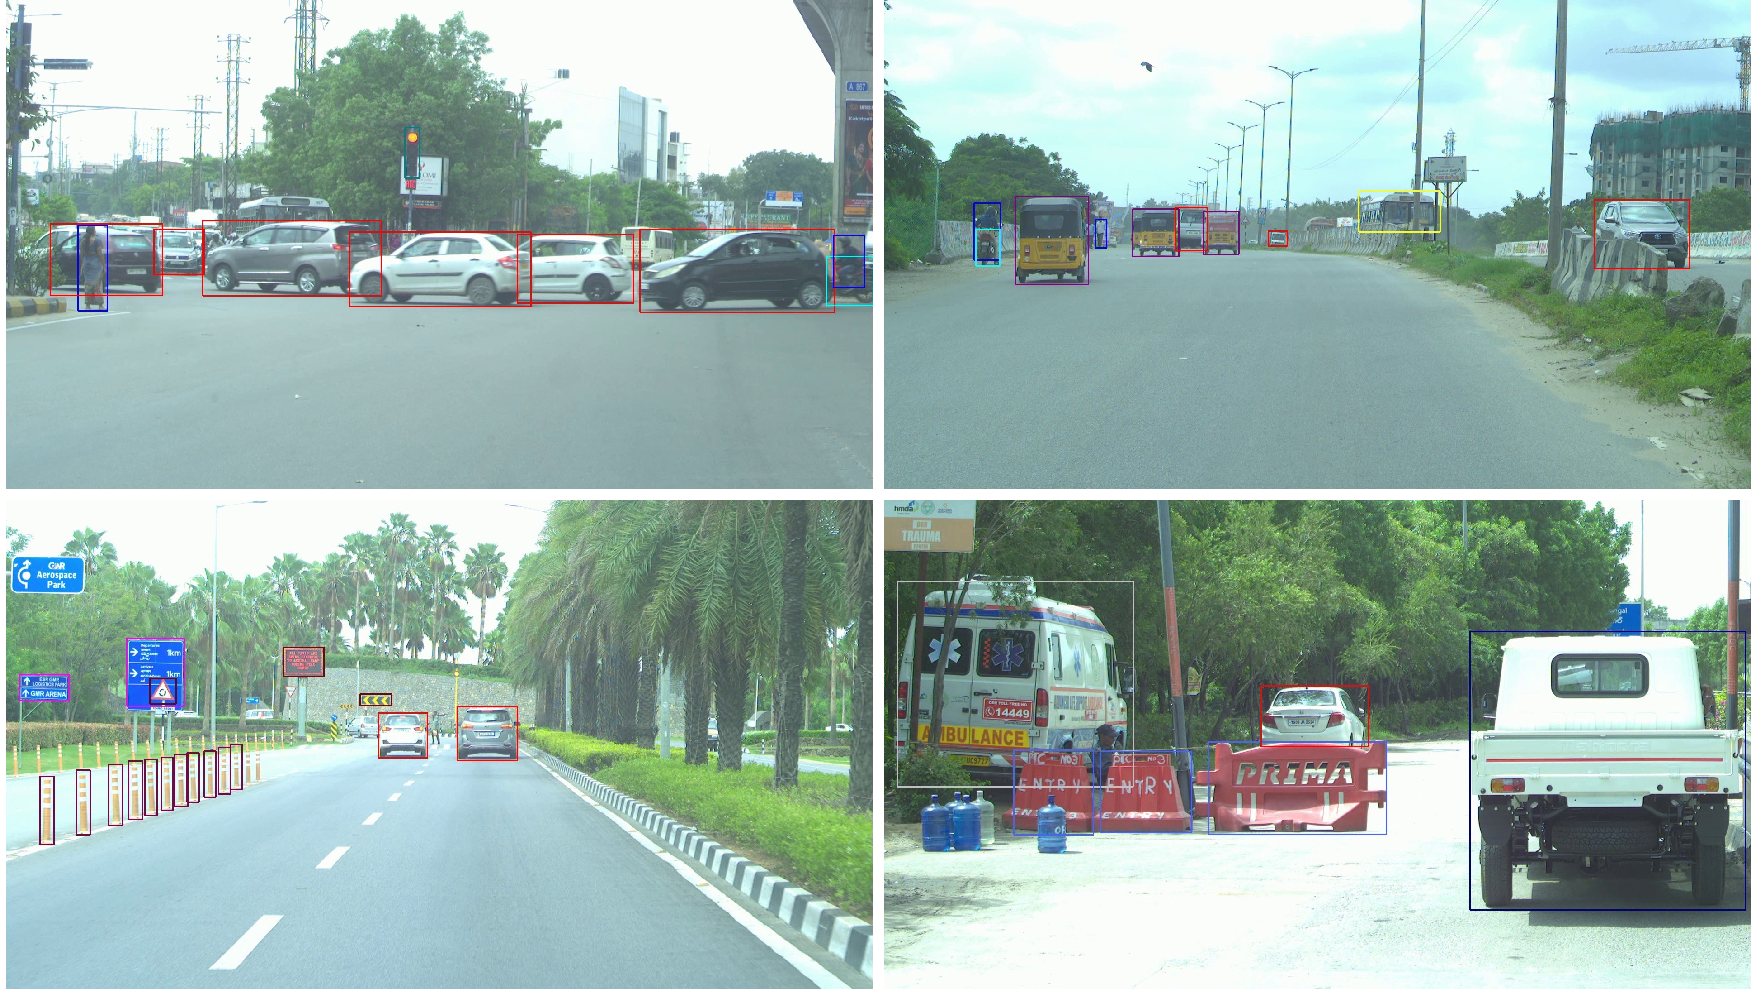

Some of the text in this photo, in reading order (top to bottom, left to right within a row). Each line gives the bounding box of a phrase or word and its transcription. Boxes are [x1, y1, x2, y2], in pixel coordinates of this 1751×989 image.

[849, 83, 854, 91] A
[902, 530, 941, 542] TRAUMA
[47, 562, 66, 570] GMR
[37, 571, 77, 580] Aerospace
[47, 580, 66, 588] Park
[995, 708, 1030, 718] 14449
[1236, 760, 1353, 785] PRIMA
[1018, 777, 1081, 794] ENTRY
[1106, 776, 1173, 797] ENTRY
[1102, 811, 1165, 819] ENTRY
